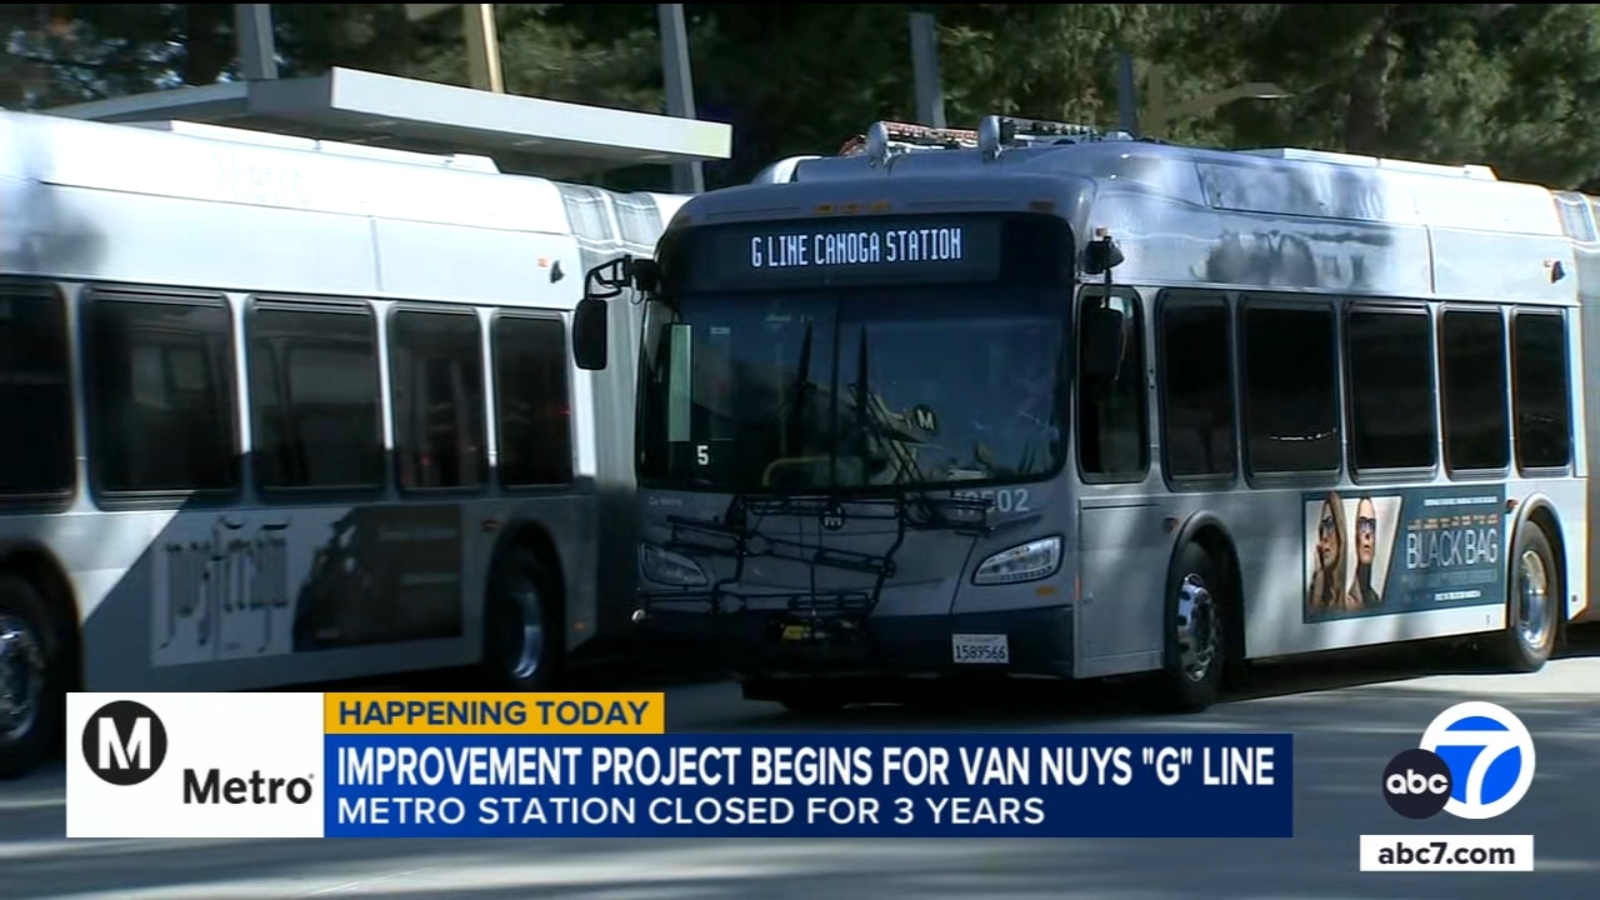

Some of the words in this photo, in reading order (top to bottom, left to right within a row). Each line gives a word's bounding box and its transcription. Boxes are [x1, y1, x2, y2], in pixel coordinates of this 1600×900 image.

[752, 237, 762, 266] G
[768, 235, 808, 266] LINE
[814, 232, 880, 264] CANOGA
[886, 228, 961, 262] STATION
[697, 445, 708, 465] 5
[1406, 530, 1463, 569] BLACK
[1465, 528, 1498, 566] BAG
[956, 645, 1006, 660] 1589566
